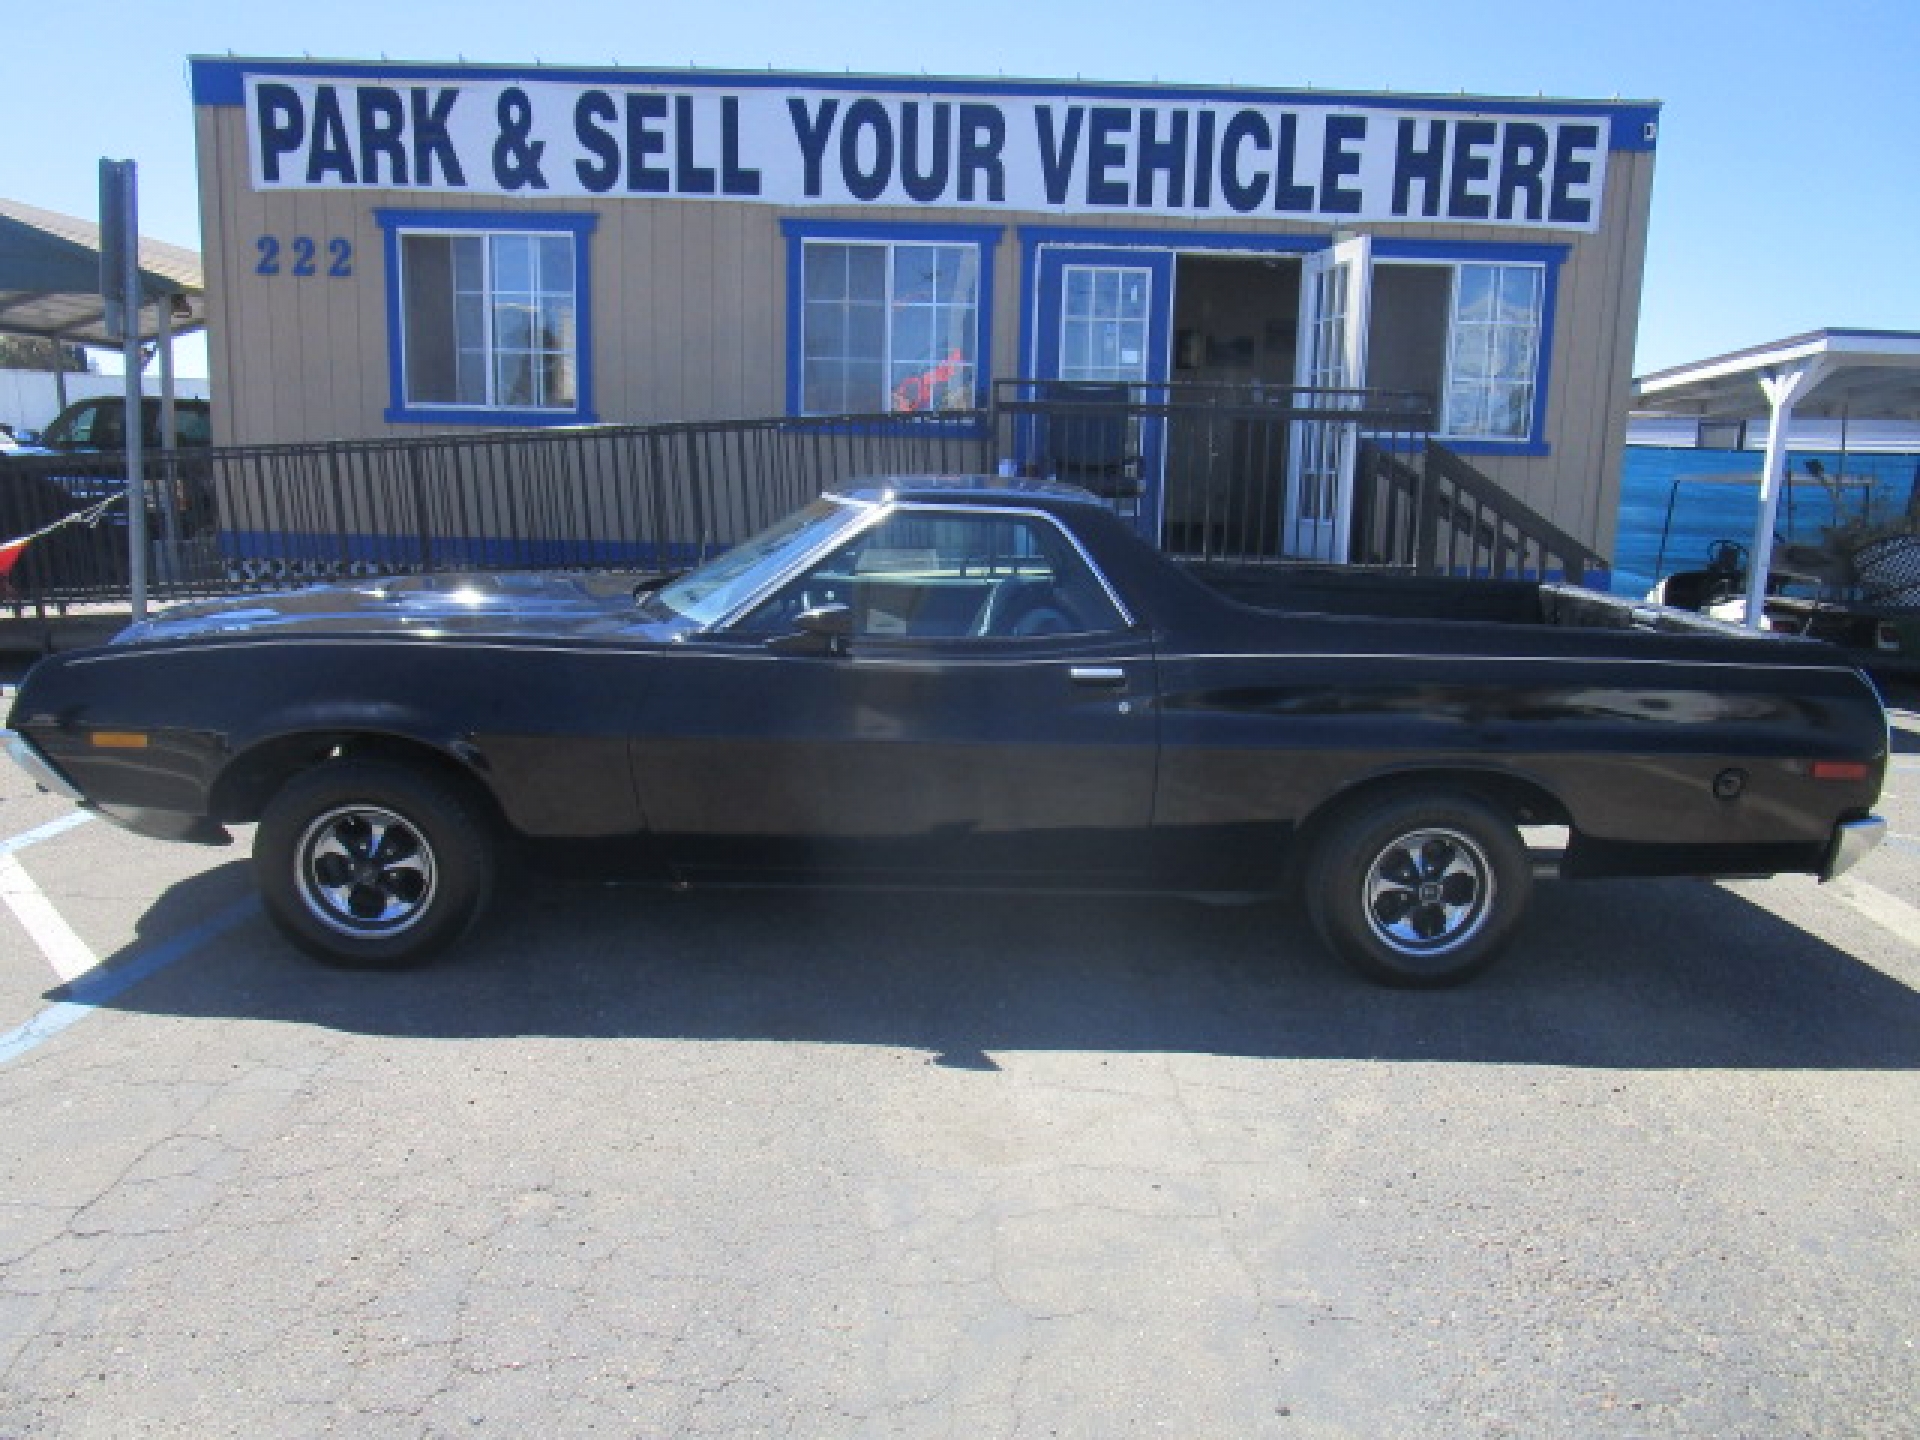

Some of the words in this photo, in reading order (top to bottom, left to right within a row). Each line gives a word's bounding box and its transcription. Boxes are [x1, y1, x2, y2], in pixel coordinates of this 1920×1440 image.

[256, 84, 466, 187] PARK
[493, 87, 547, 190] &
[574, 89, 761, 194] SELL
[789, 97, 1006, 202] YOUR
[1035, 105, 1368, 214] VEHICLE
[1391, 117, 1600, 223] HERE
[255, 236, 353, 277] 222
